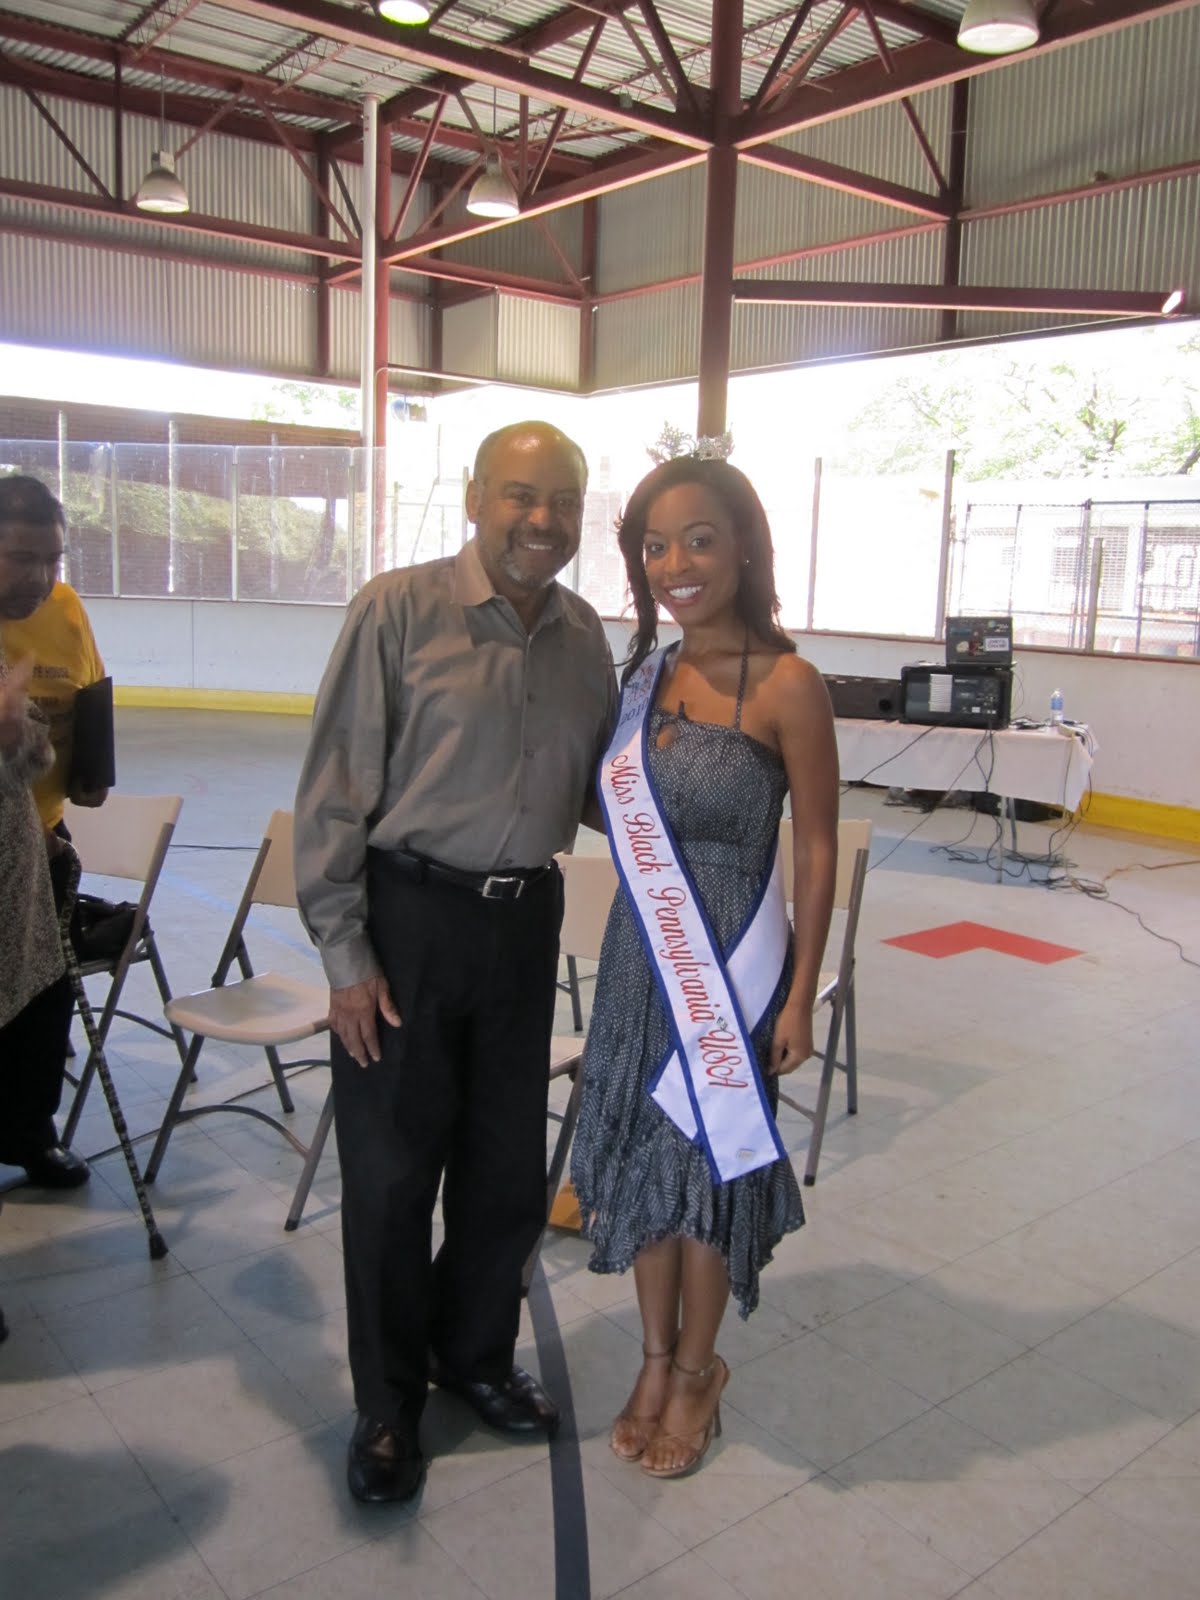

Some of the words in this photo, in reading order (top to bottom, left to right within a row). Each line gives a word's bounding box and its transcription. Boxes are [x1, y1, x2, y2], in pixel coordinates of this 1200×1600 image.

[610, 754, 641, 805] Miss
[623, 813, 672, 875] Black
[647, 886, 721, 1023] Pennsylvania
[698, 1030, 749, 1089] USA
